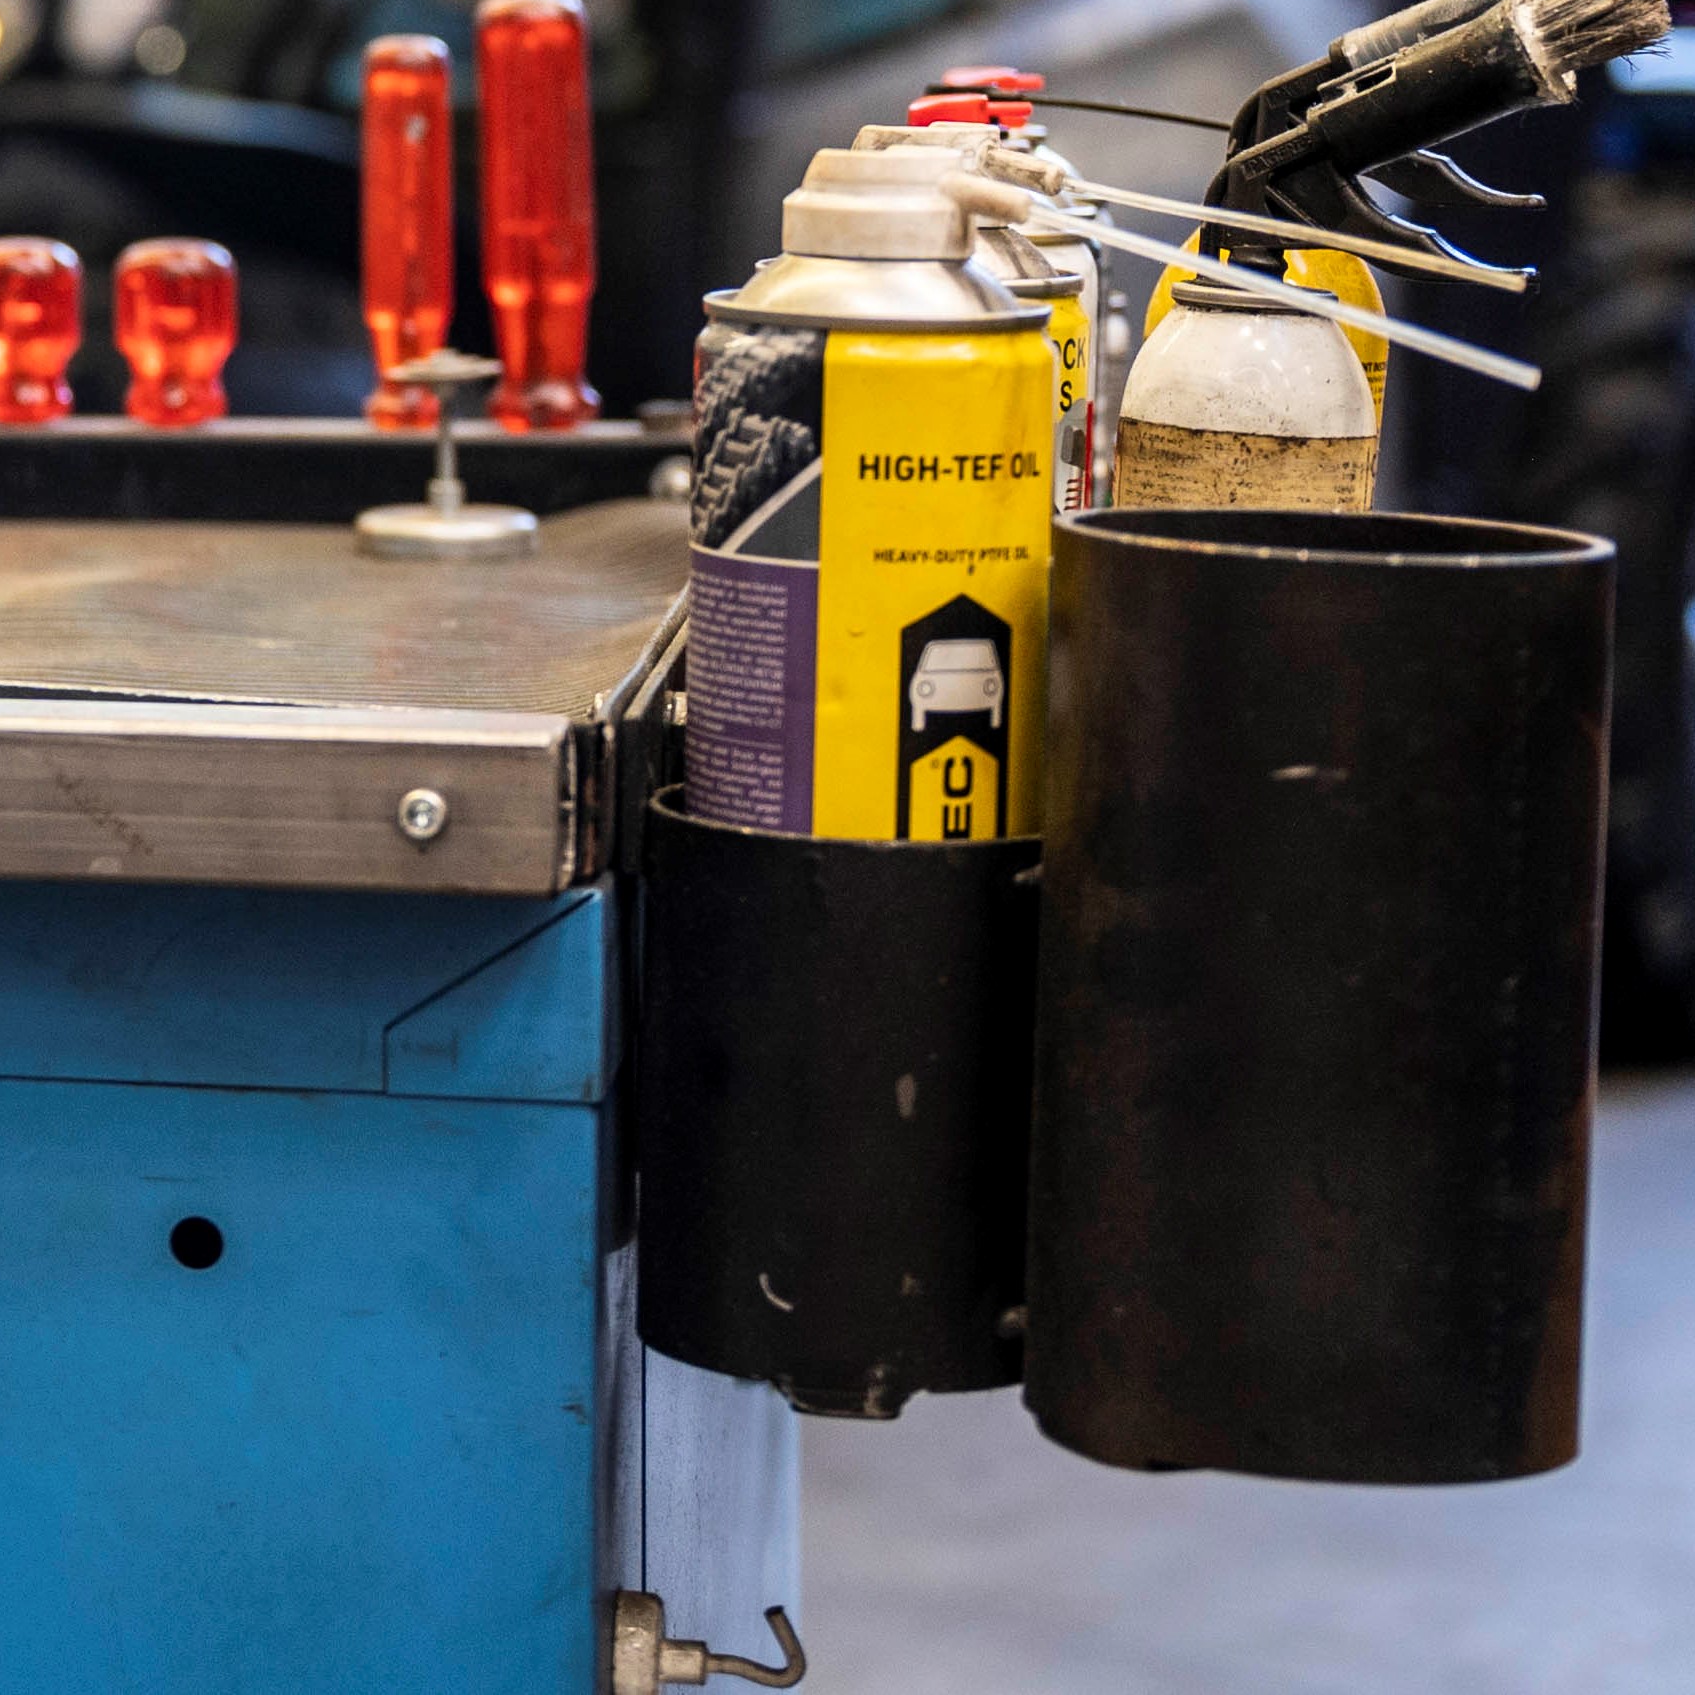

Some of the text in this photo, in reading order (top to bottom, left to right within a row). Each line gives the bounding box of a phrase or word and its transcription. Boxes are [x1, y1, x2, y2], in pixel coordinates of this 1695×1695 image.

[1053, 338, 1086, 369] CK
[859, 452, 1040, 481] HIGH-TEF OIL
[943, 755, 973, 839] EC
